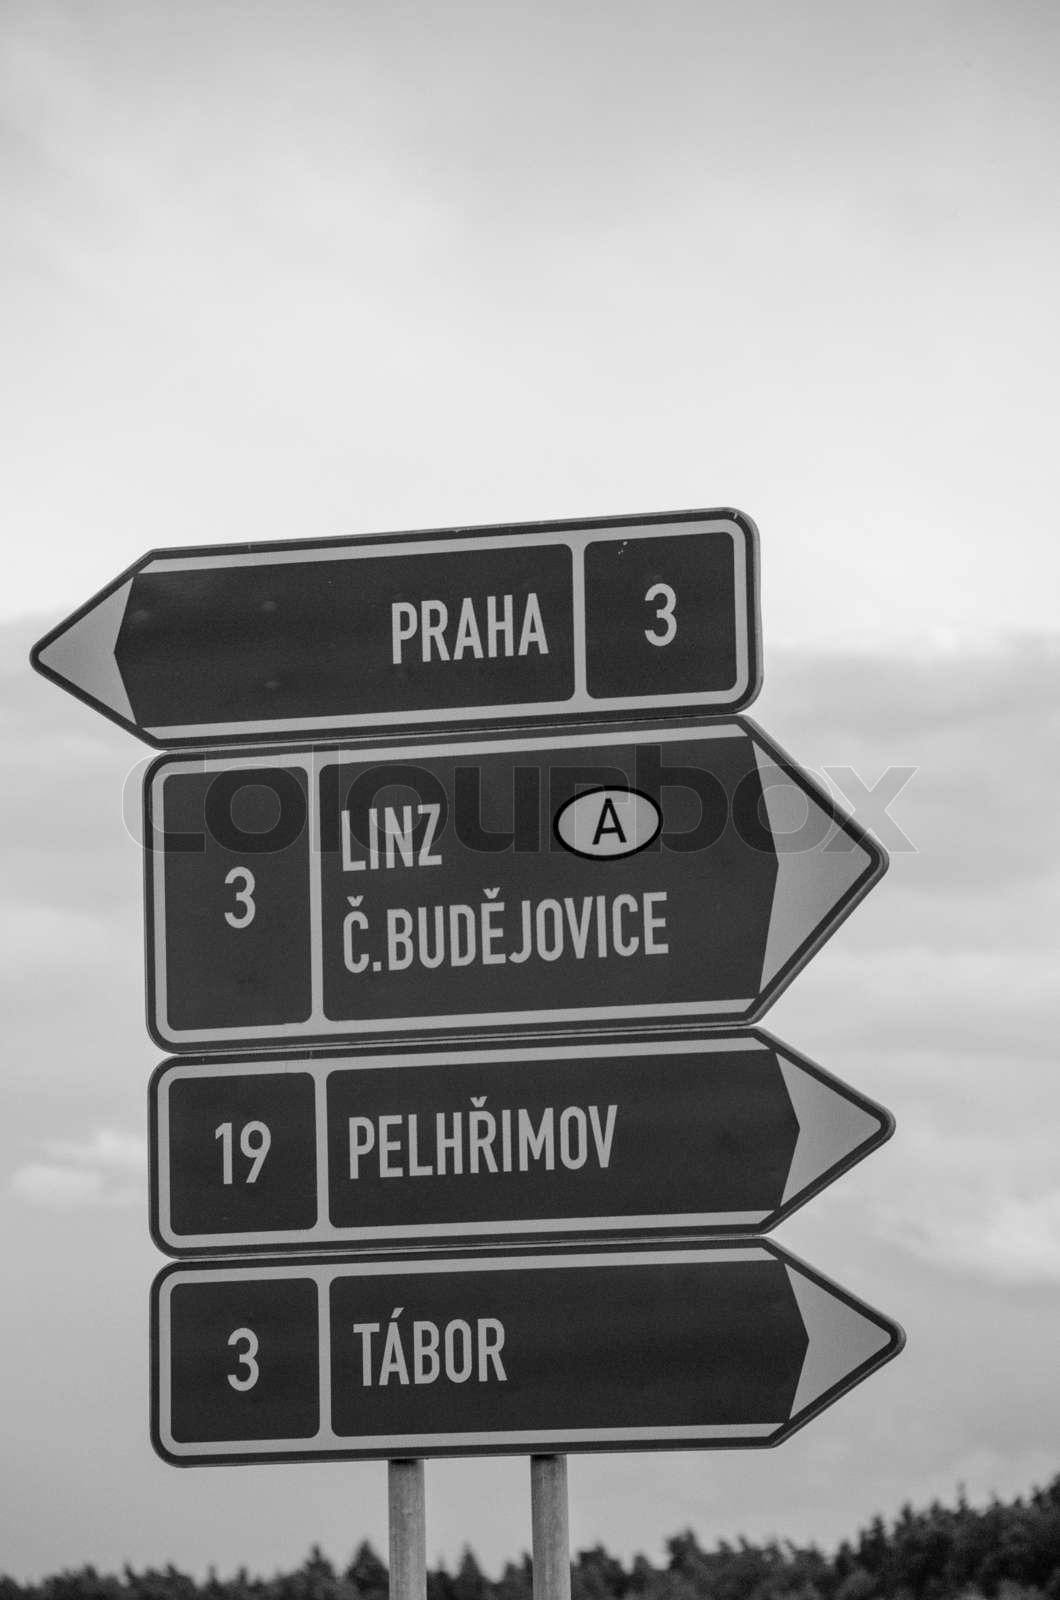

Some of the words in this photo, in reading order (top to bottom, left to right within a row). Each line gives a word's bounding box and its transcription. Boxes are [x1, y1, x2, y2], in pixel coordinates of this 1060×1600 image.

[391, 592, 549, 665] PRAHA
[644, 583, 677, 647] 3
[341, 803, 442, 872] LINZ
[592, 798, 627, 846] A
[224, 866, 256, 929] 3
[215, 1120, 271, 1185] 19
[349, 1095, 618, 1180] PELHŘIMOV
[227, 1327, 259, 1392] 3
[353, 1307, 507, 1387] TÁBOR
